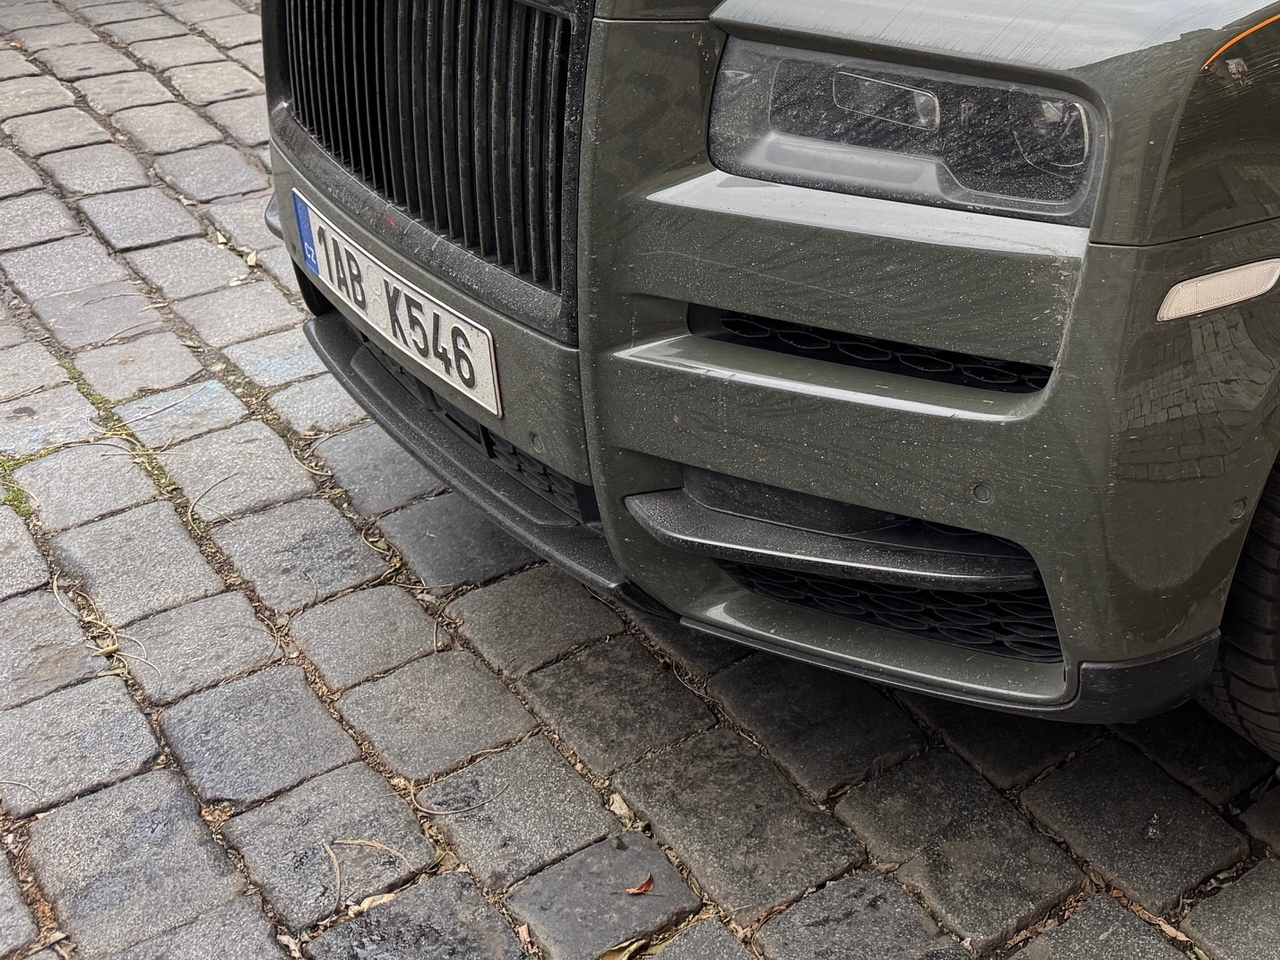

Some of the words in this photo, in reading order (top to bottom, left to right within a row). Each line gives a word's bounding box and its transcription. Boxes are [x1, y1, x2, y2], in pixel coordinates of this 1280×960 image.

[304, 241, 317, 265] CZ
[317, 223, 367, 312] 1AB
[383, 277, 477, 390] K546
